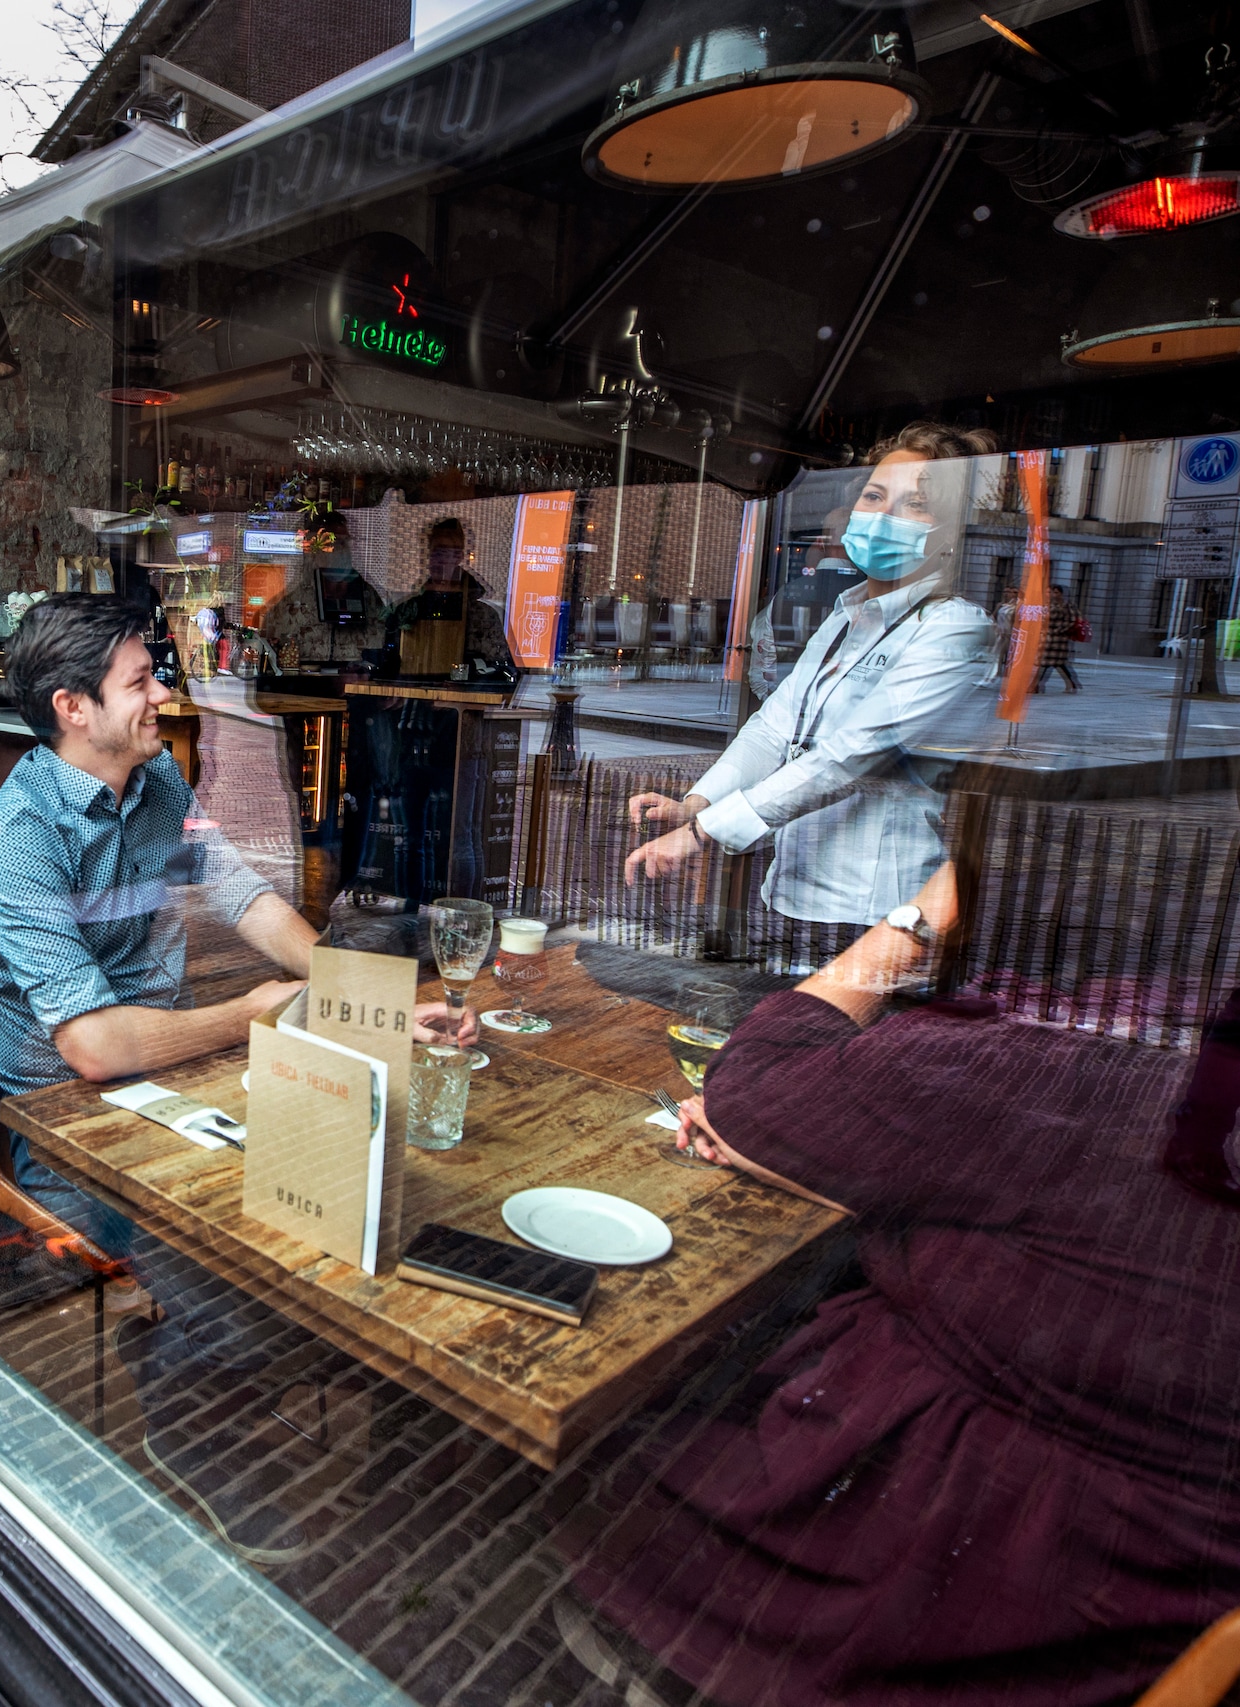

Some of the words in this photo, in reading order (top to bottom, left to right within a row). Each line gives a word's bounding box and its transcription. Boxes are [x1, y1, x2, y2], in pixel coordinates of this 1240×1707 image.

[339, 314, 446, 366] Heineke
[320, 998, 406, 1032] UBICA
[271, 1060, 299, 1083] UBICA
[276, 1186, 324, 1219] UBICA
